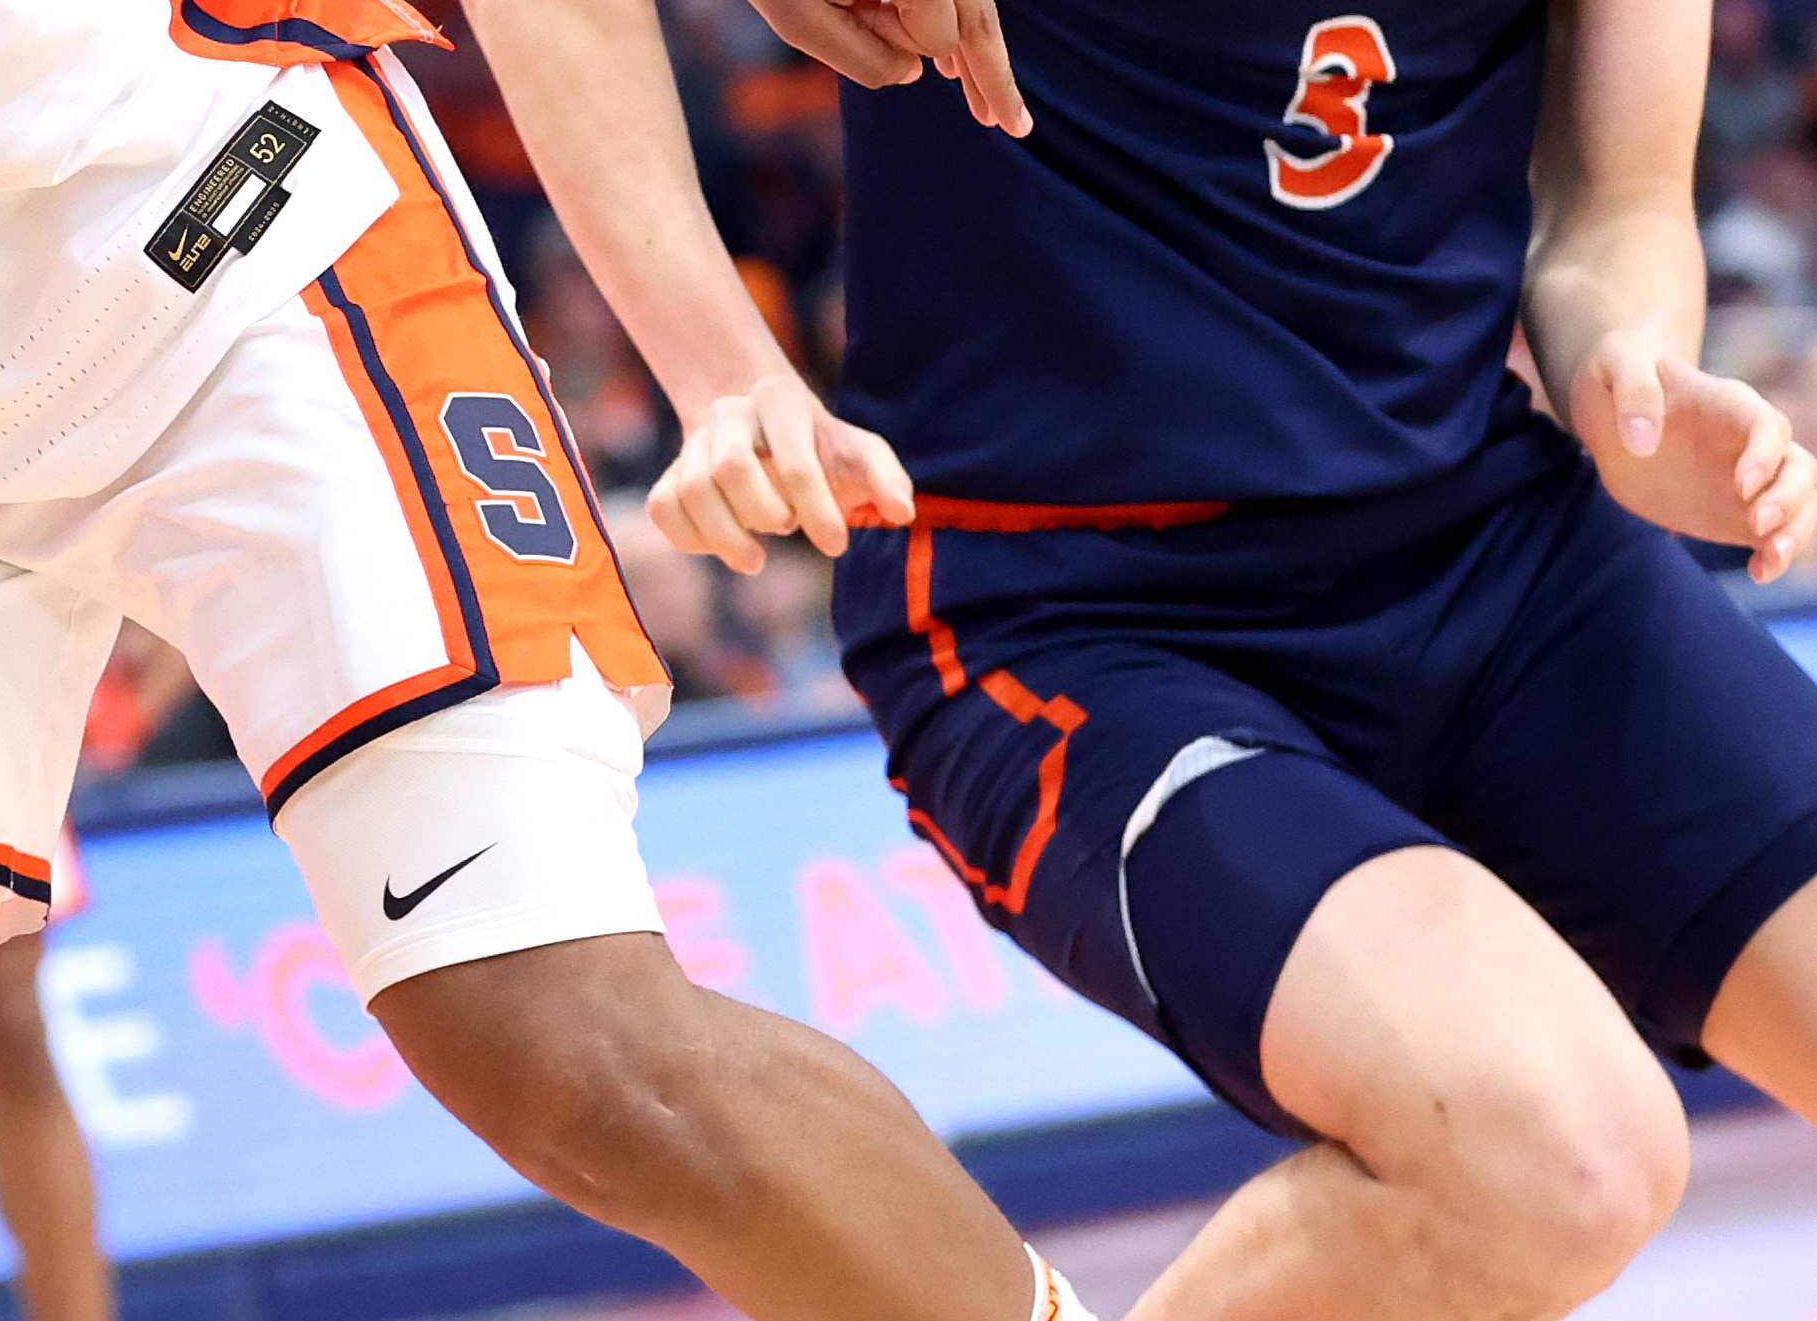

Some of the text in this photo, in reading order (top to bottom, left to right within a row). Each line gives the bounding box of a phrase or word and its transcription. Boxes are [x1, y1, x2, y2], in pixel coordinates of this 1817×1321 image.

[249, 133, 286, 164] 52
[1263, 15, 1395, 210] 3
[439, 392, 579, 565] S
